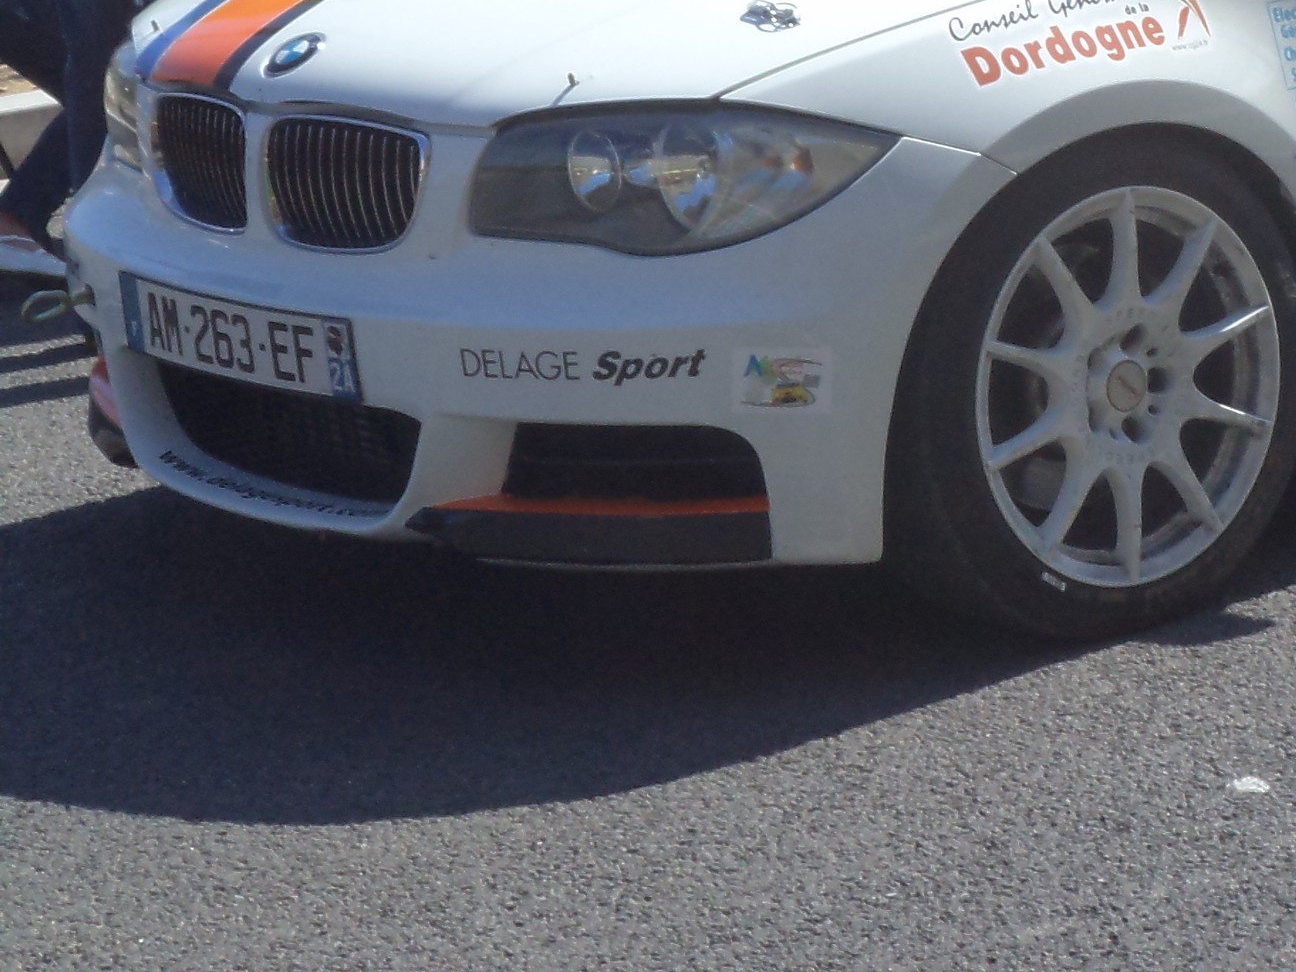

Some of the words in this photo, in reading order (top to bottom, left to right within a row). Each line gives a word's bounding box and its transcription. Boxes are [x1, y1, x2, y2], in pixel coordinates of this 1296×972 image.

[960, 15, 1166, 87] Dordogne
[459, 347, 581, 380] DELAGE
[591, 349, 707, 386] Sport
